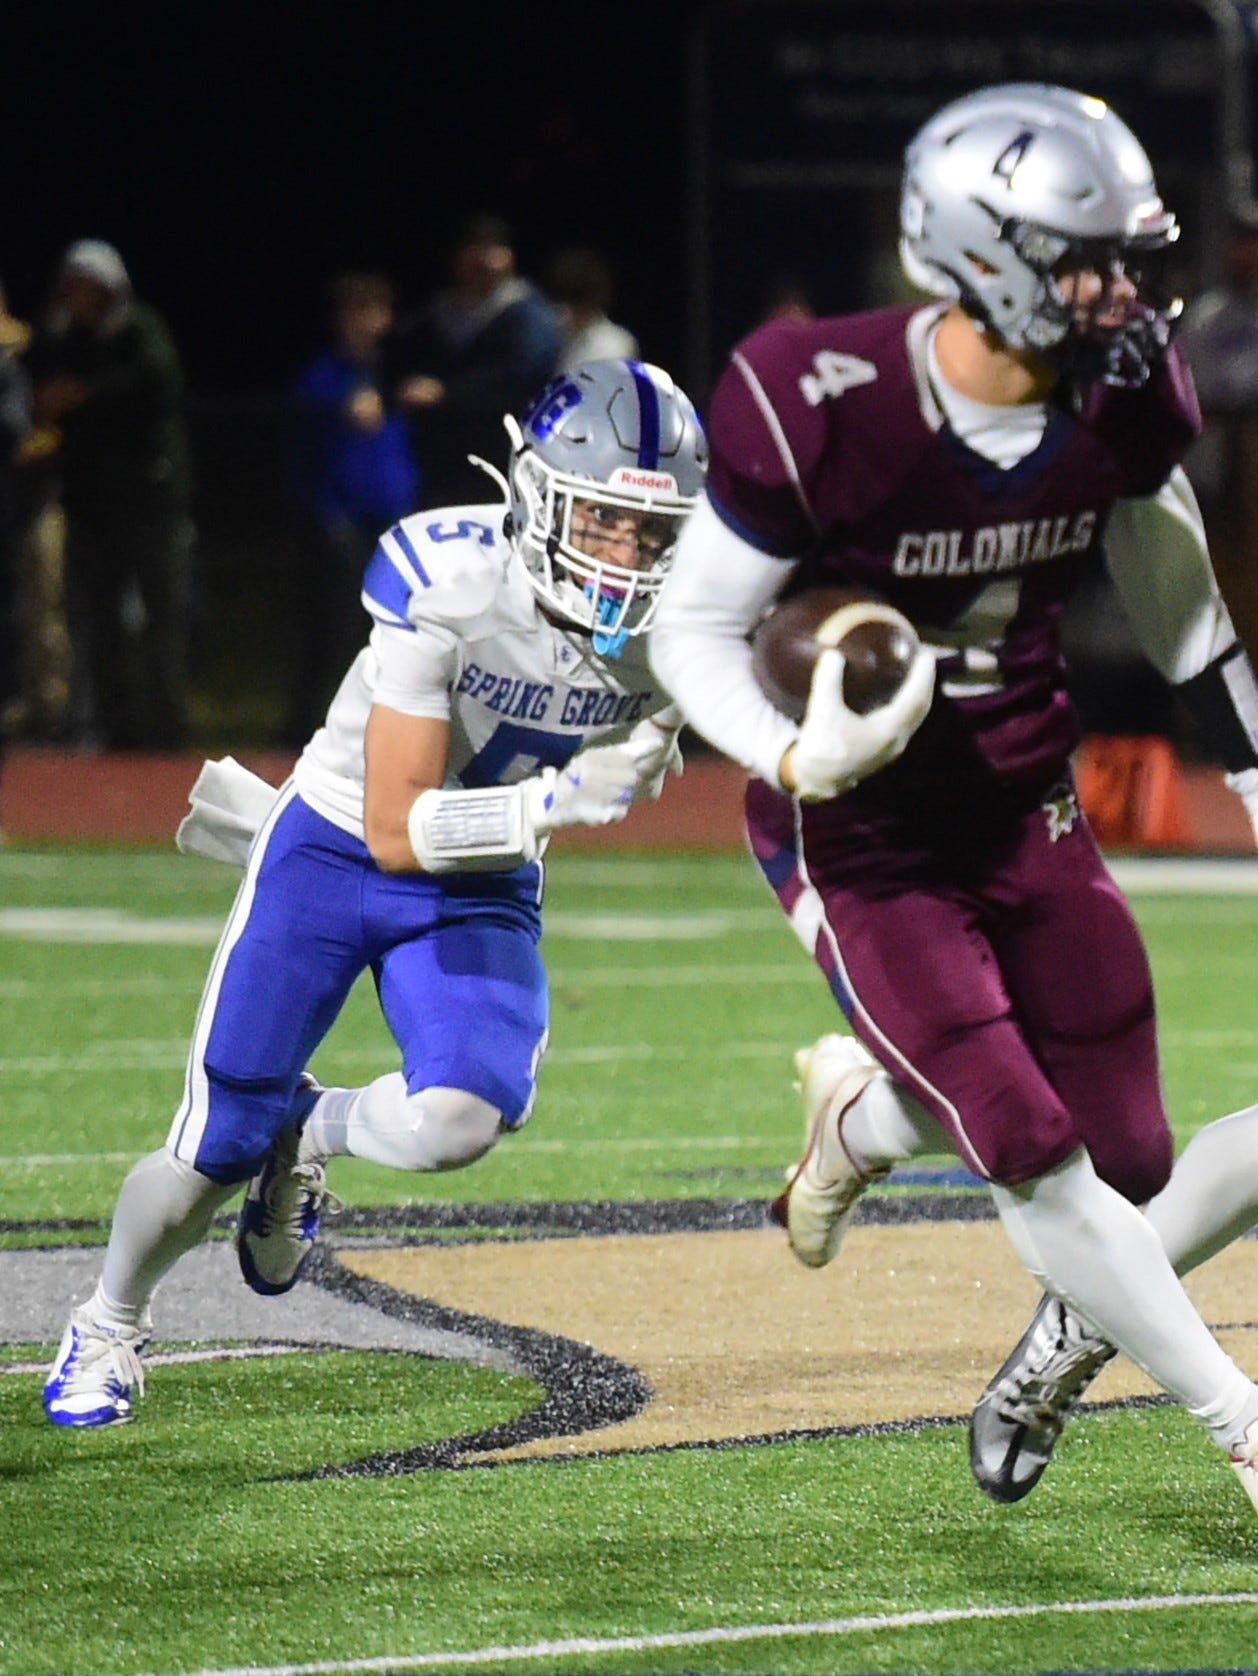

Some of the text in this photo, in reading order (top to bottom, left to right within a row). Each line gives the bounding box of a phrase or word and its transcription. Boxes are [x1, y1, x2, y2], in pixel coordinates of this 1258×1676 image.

[992, 130, 1036, 190] 4
[798, 348, 878, 408] 4
[621, 471, 673, 490] Riddell
[426, 520, 496, 548] 5
[892, 509, 1097, 578] COLONIALS
[457, 663, 654, 727] SPRING GROVE
